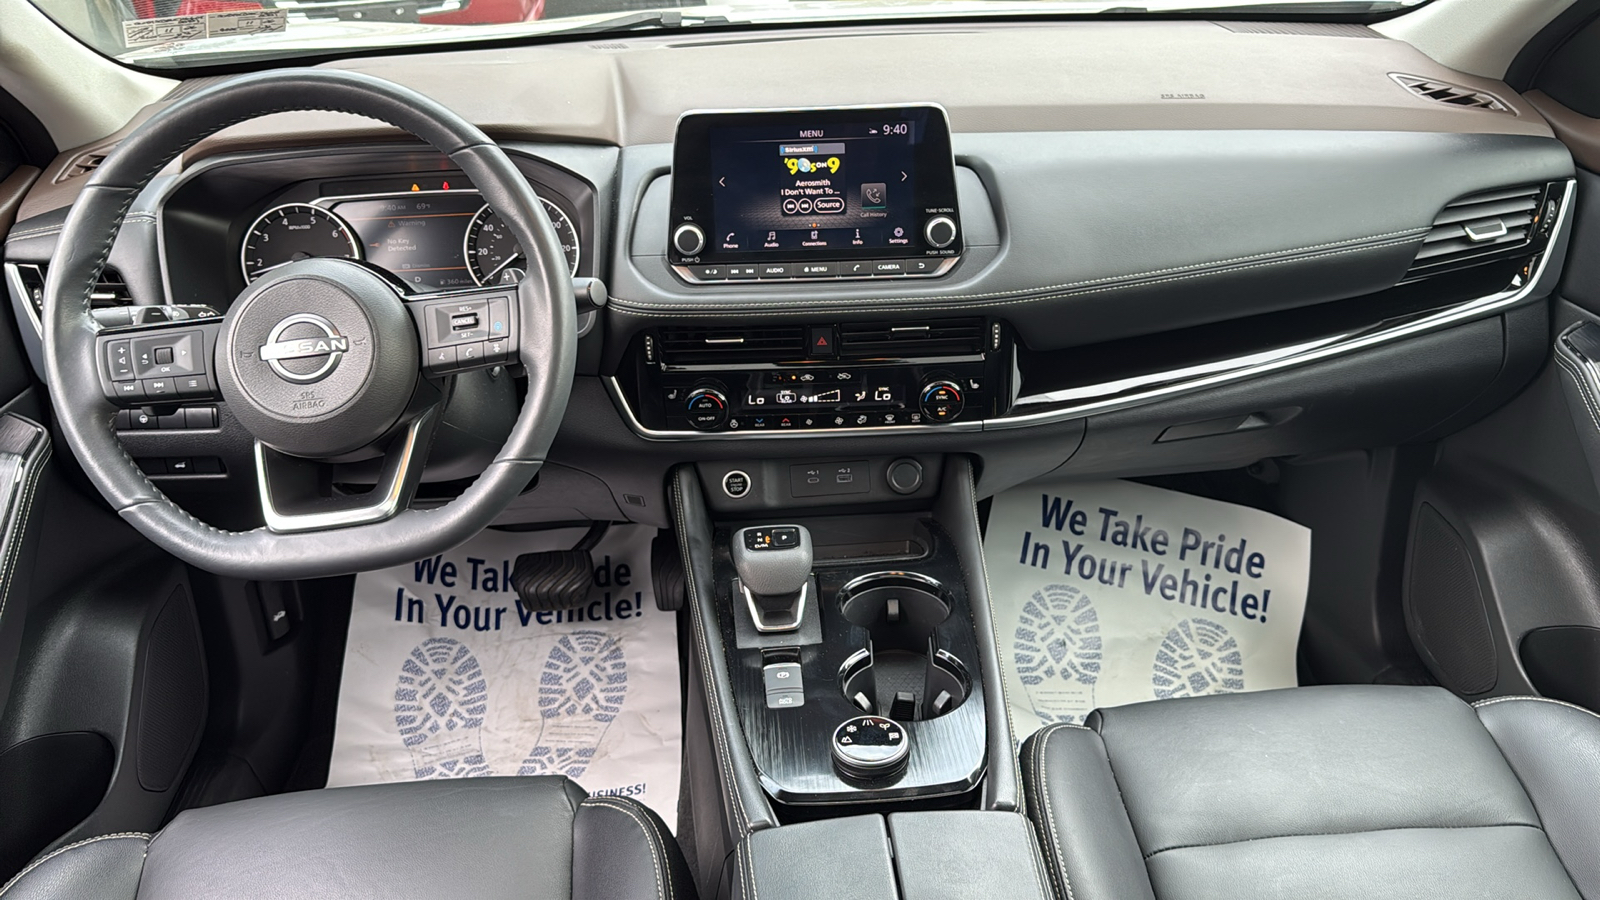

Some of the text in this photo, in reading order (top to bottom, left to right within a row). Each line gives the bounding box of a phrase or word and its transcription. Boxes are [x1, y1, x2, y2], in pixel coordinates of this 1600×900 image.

[882, 124, 908, 134] 9:40
[799, 130, 824, 138] MENU
[827, 156, 840, 174] 9
[795, 179, 831, 187] Aerosmith
[785, 188, 804, 196] Don't
[817, 201, 841, 209] Source
[282, 218, 288, 226] 4
[310, 216, 317, 225] 5
[483, 224, 494, 232] 40
[263, 234, 269, 242] 3
[332, 230, 338, 238] 6
[388, 244, 417, 252] Detected
[478, 248, 488, 256] 20
[257, 259, 263, 267] 2
[454, 317, 474, 325] CANCEL
[301, 391, 315, 400] SRS
[875, 391, 891, 401] Lo
[748, 395, 765, 405] Lo
[293, 400, 325, 410] AIRBAG
[1041, 494, 1266, 579] We Take Pride
[414, 554, 516, 593] We Tak
[1019, 531, 1271, 624] In Your Vehicle!
[395, 587, 424, 624] In
[434, 593, 507, 632] Your
[588, 783, 646, 797] USINESS!
